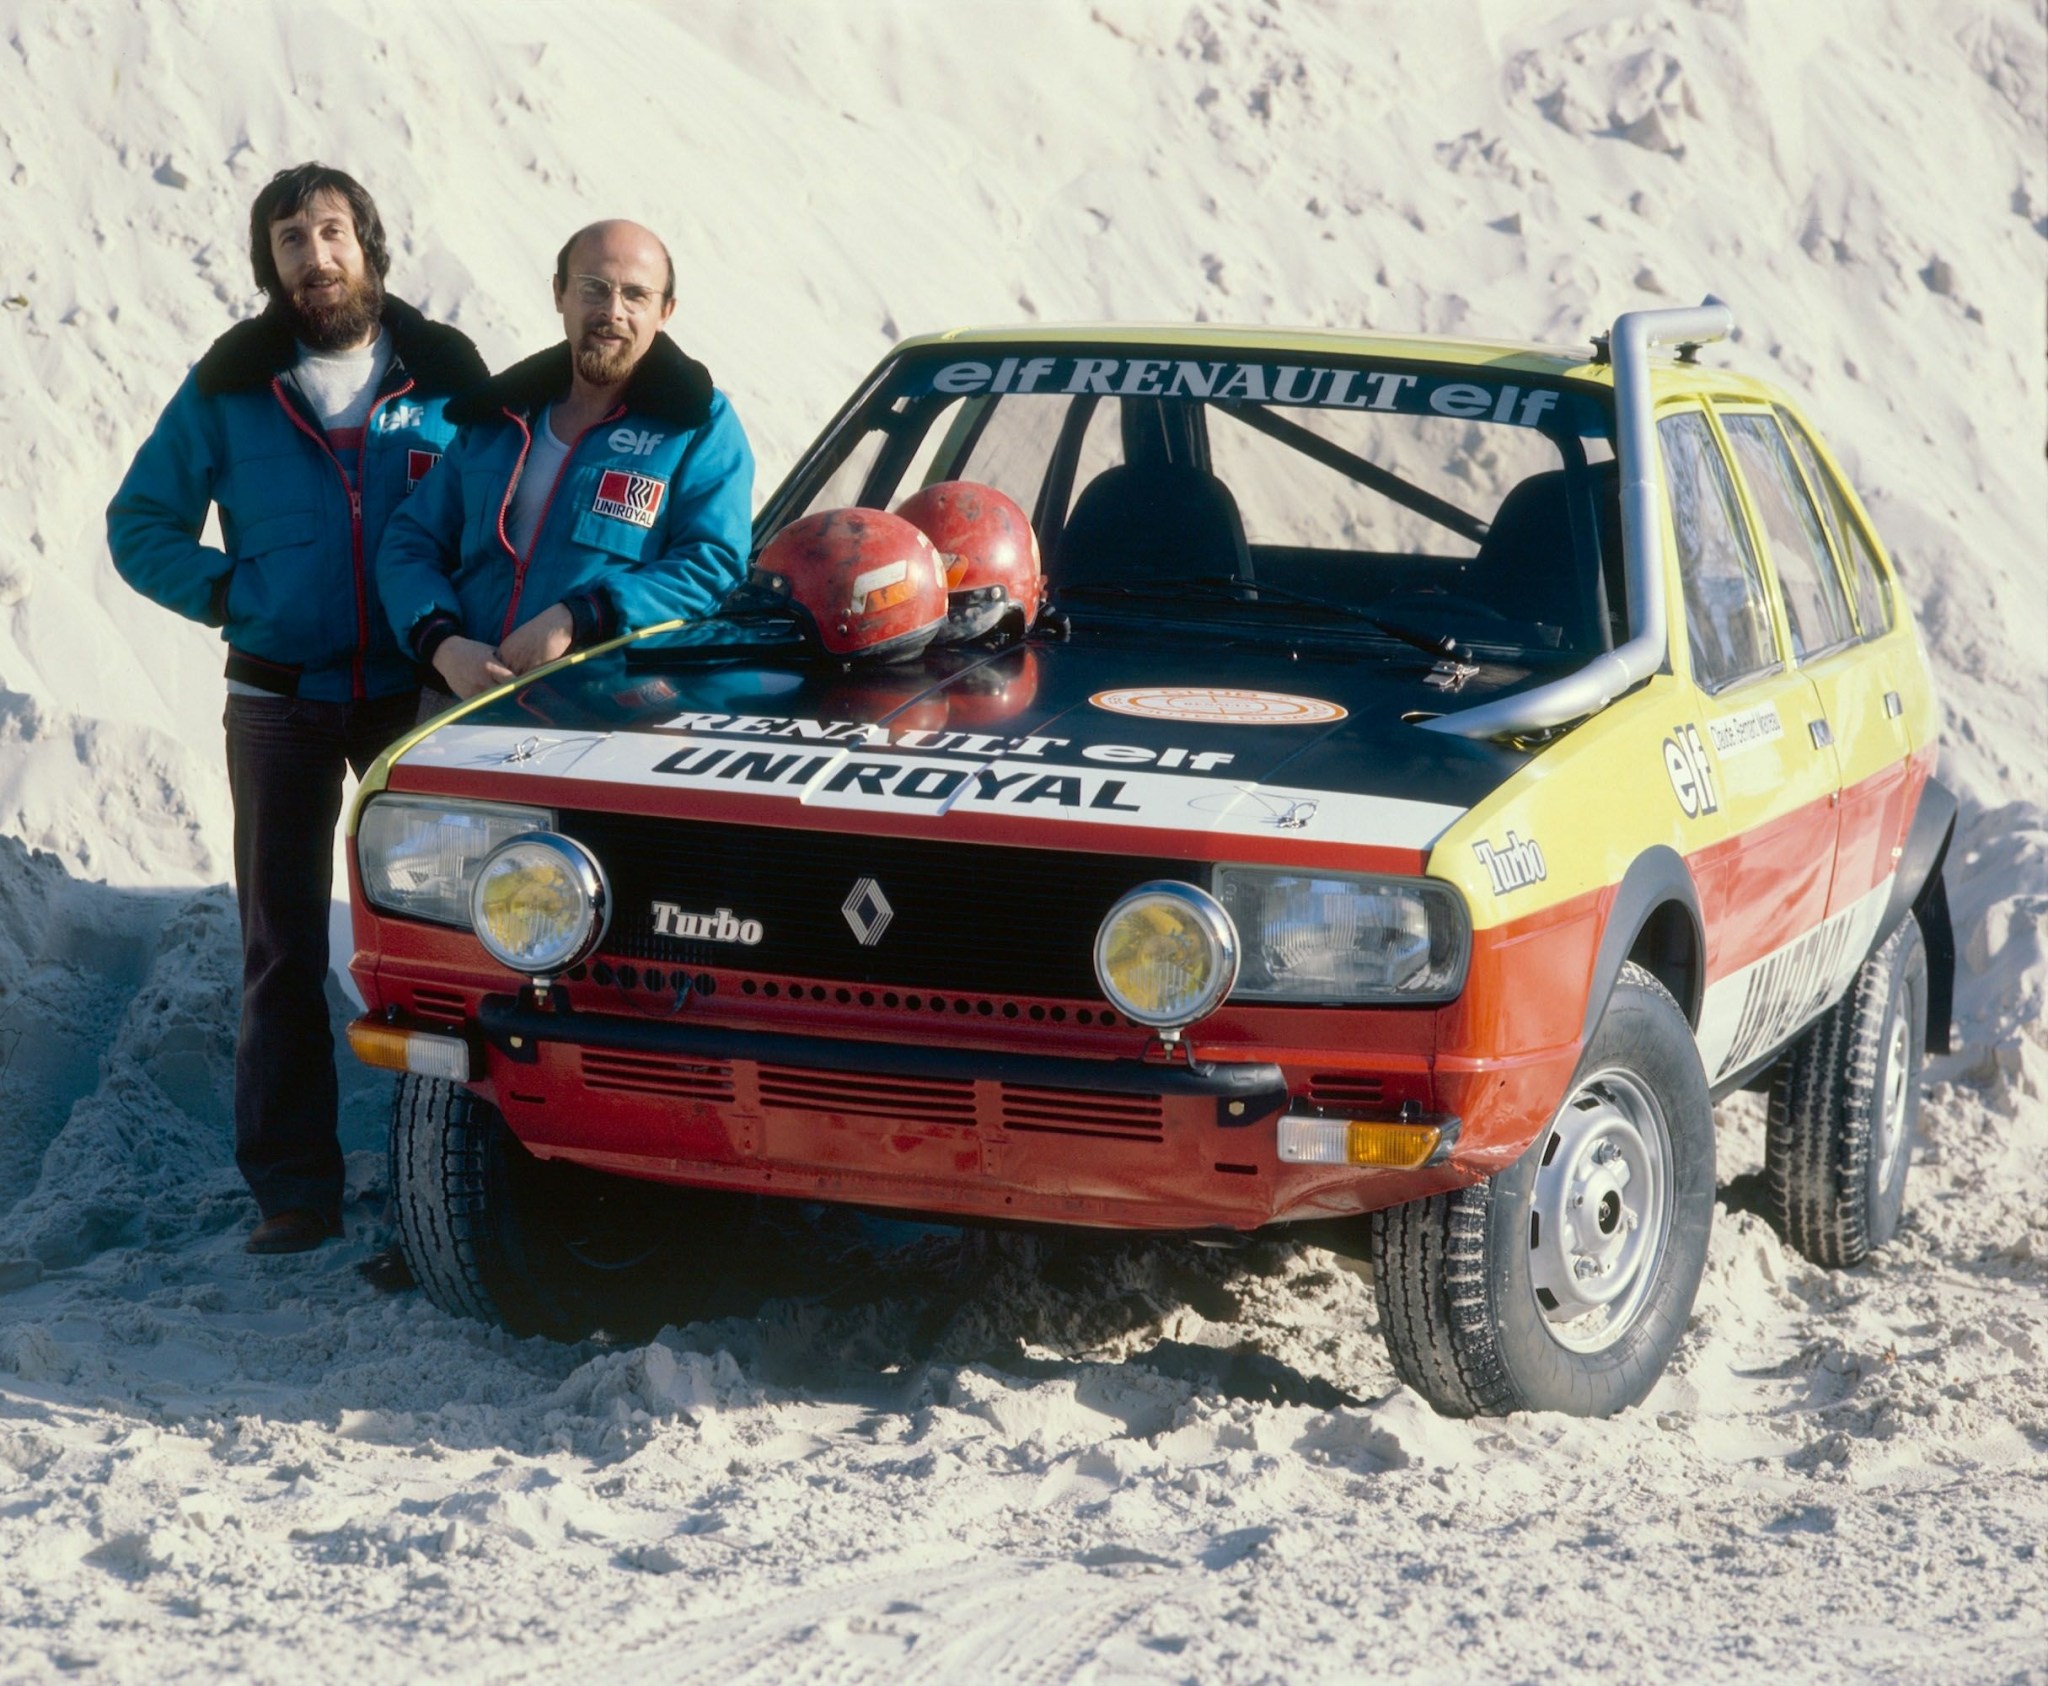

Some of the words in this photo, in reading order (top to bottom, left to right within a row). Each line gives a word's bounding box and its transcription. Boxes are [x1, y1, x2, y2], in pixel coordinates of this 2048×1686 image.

[379, 405, 424, 433] elf
[932, 357, 1054, 395] elf
[1060, 357, 1417, 411] RENAULT
[1428, 384, 1560, 427] elf
[608, 428, 665, 455] elf
[594, 499, 652, 526] UNIROYAL
[653, 711, 1071, 758] RENAULT
[1081, 744, 1237, 772] elf
[1662, 723, 1718, 819] elf
[650, 745, 1142, 812] UNIROYAL
[1472, 830, 1547, 897] Turbo
[651, 900, 764, 946] Turbo
